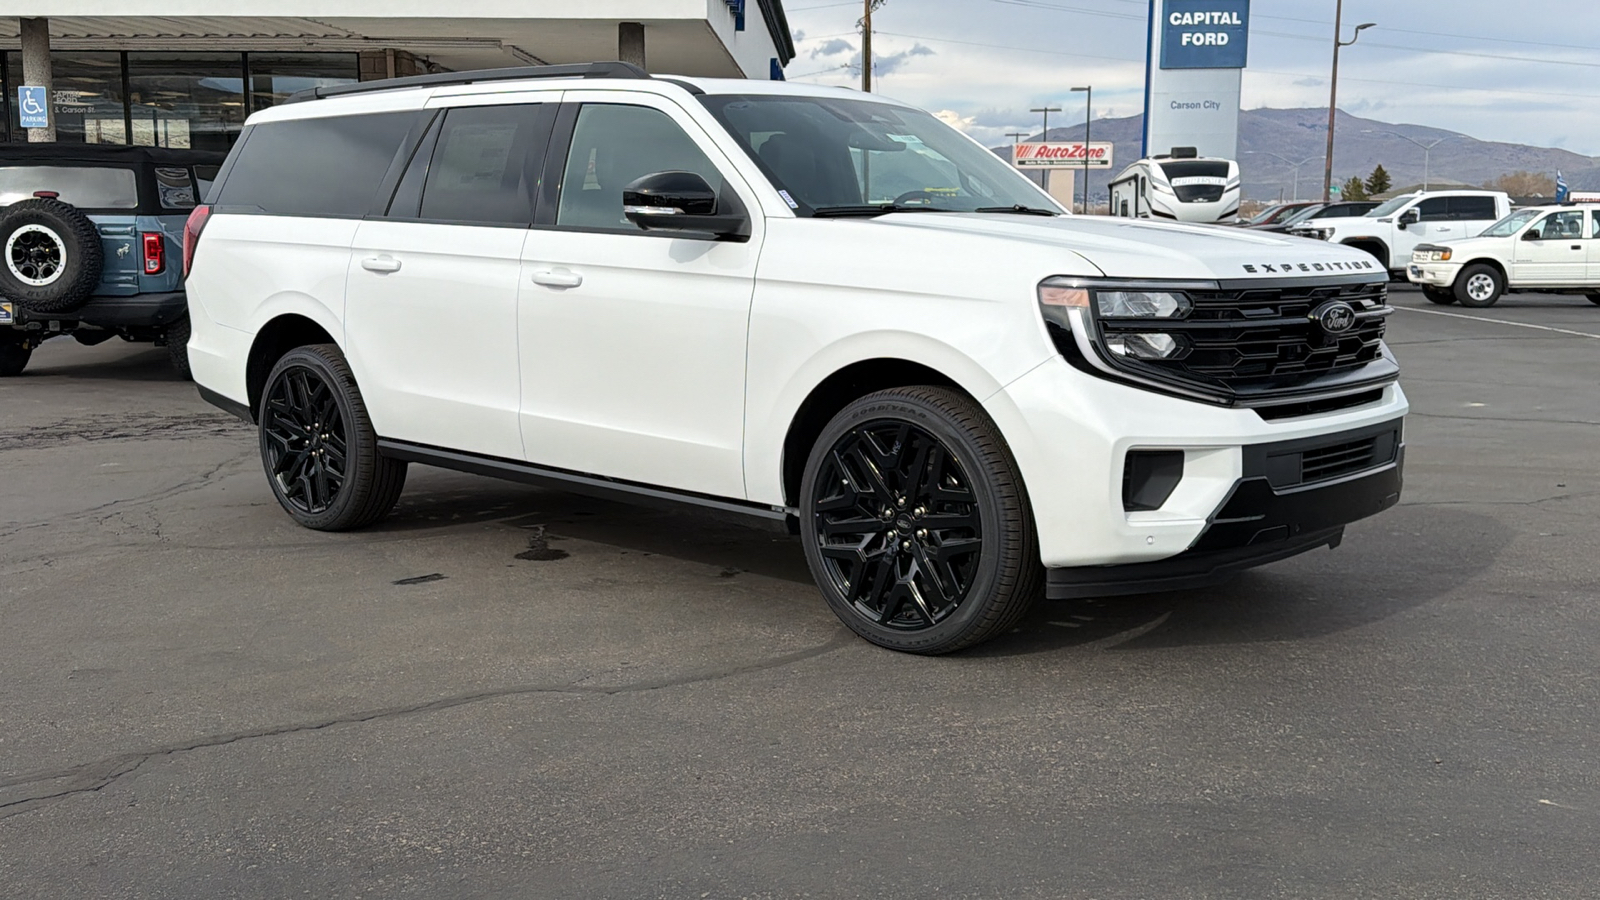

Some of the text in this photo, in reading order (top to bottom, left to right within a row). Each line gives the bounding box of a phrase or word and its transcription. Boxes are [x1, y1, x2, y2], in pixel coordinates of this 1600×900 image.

[1169, 11, 1242, 26] CAPITAL
[1181, 32, 1229, 46] FORD
[1170, 99, 1221, 111] Carson City
[21, 115, 46, 123] PARKING
[1034, 145, 1105, 158] AutoZone
[1242, 261, 1373, 274] EXPEDITION
[1327, 308, 1350, 329] Ford
[851, 404, 927, 419] GOODYEAR
